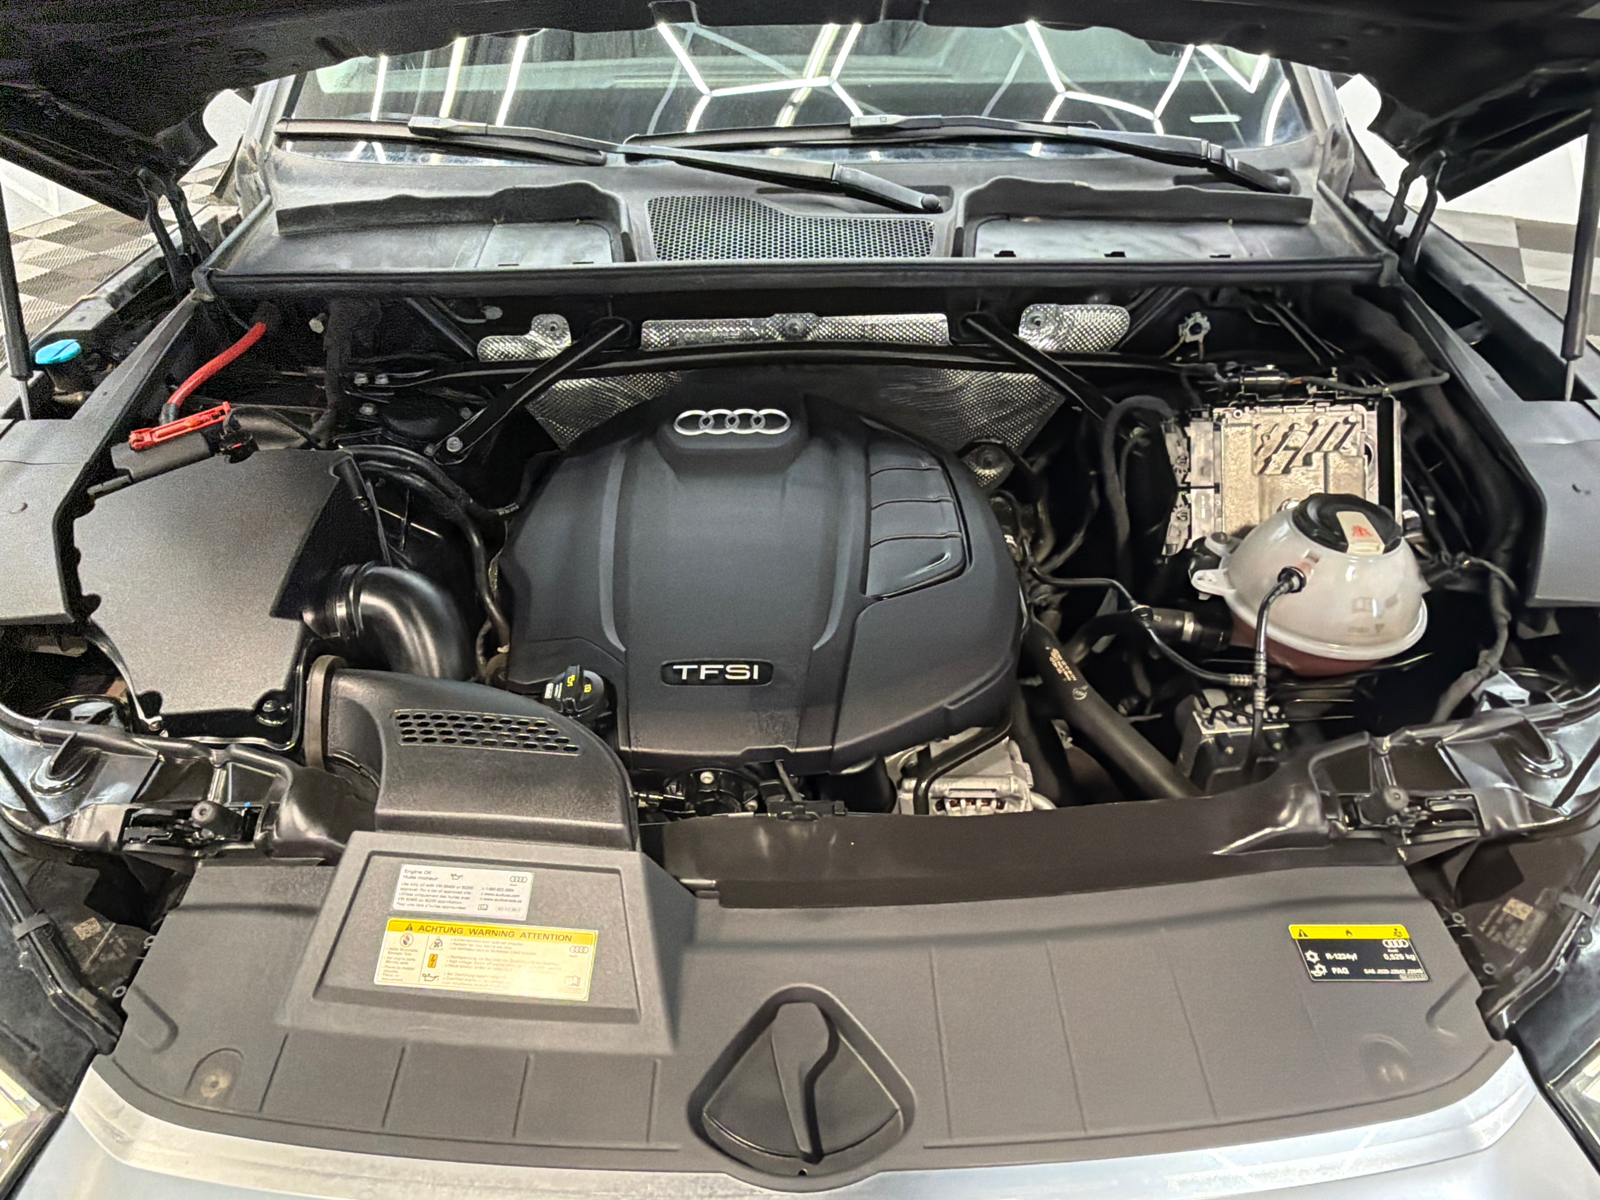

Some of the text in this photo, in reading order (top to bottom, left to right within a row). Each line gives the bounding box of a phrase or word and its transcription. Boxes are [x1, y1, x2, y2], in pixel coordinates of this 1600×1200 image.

[672, 664, 759, 680] TFSI
[418, 924, 573, 942] ACHTUNG WARNING ATTENTION
[1404, 953, 1417, 961] kg
